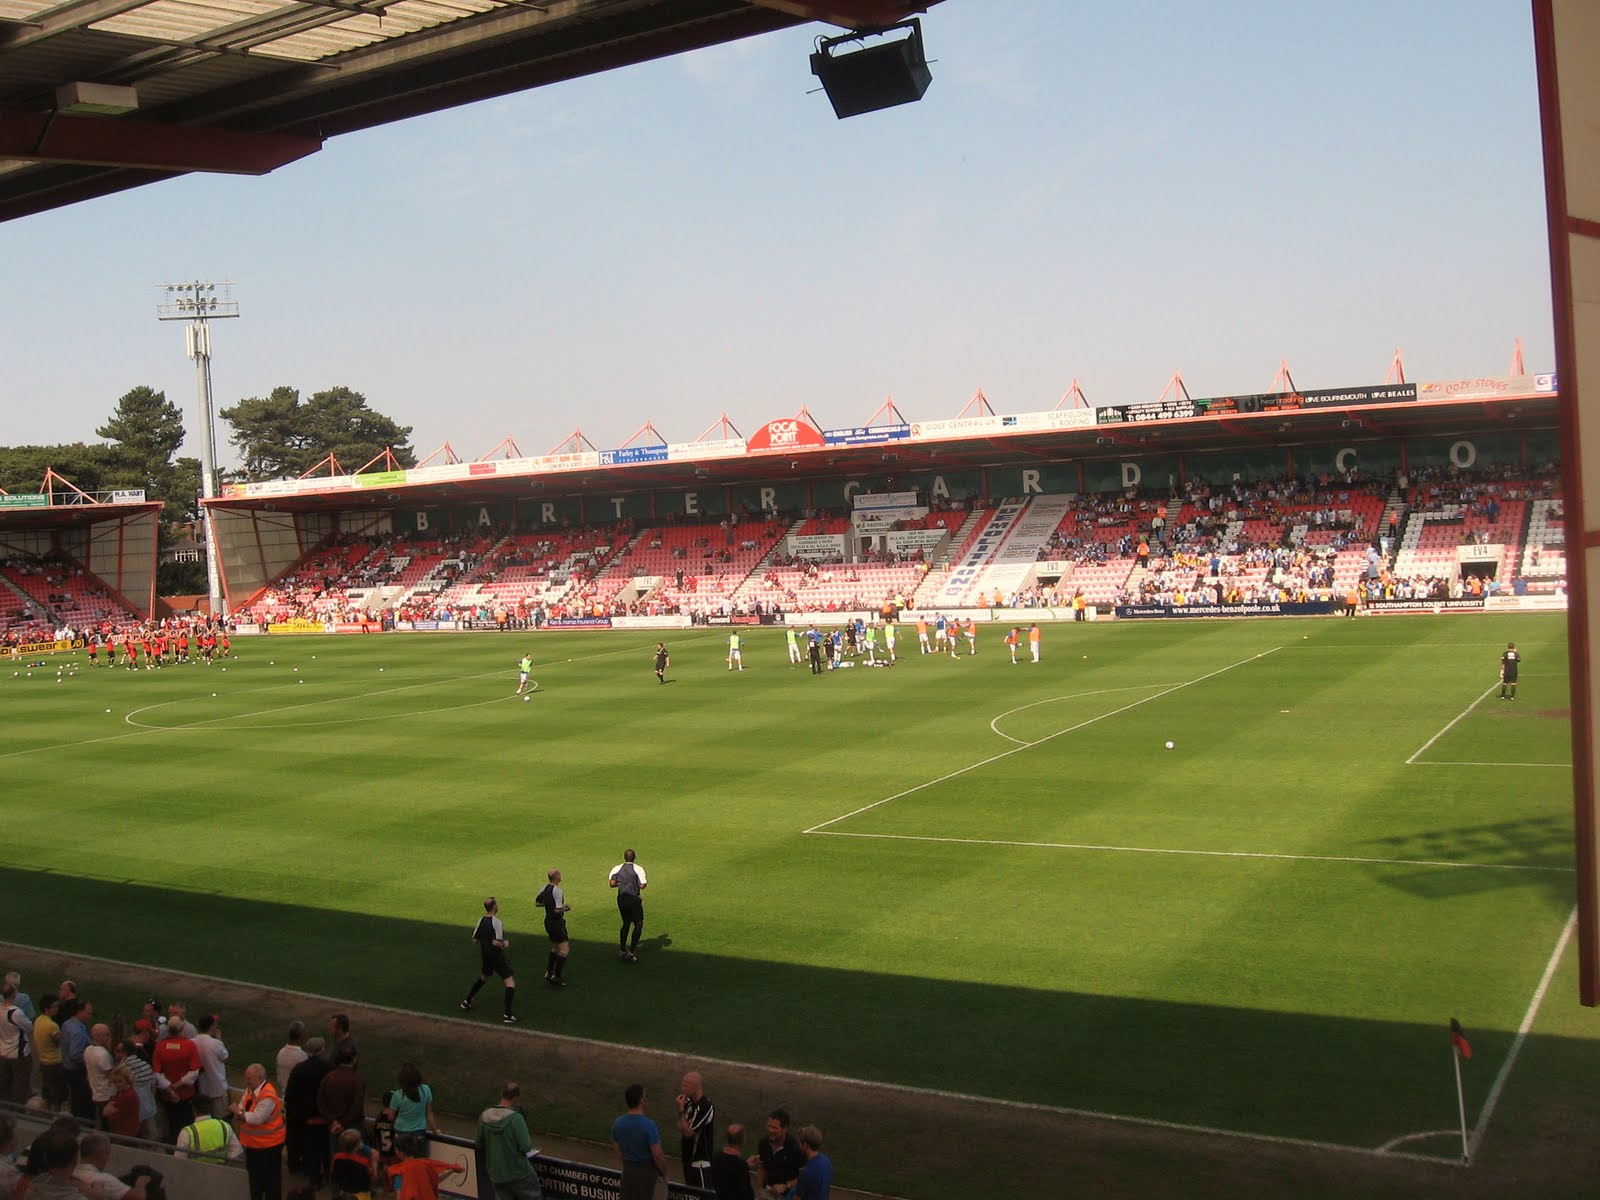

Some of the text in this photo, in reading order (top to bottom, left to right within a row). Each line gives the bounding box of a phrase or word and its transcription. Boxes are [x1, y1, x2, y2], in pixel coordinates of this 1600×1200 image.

[1445, 381, 1471, 395] COZY
[1475, 378, 1510, 391] STOVES
[1320, 393, 1368, 403] BOURNEMOUTH
[1387, 389, 1415, 398] BEALES
[1047, 409, 1093, 421] SCAFFOLDING
[1135, 412, 1156, 421] 0844
[1157, 411, 1173, 420] 499
[1173, 409, 1194, 418] 6399
[768, 420, 799, 434] FOCAL
[925, 418, 997, 431] GOLF CENTRAL UK
[1059, 417, 1090, 426] ROOFING
[769, 431, 798, 443] POINT
[618, 449, 635, 459] Farley
[634, 448, 640, 456] &
[4, 494, 46, 502] SOLUTIONS
[128, 489, 144, 498] HART
[1473, 545, 1488, 556] EV4
[1046, 562, 1060, 572] EV3
[1172, 603, 1281, 615] www.mercedes-benzofpoole.co.uk
[1375, 599, 1484, 609] SOUTHAMPTON SOLENT UNIVERSITY
[595, 617, 609, 625] Group
[708, 614, 731, 624] Seward
[549, 1165, 588, 1182] CHAMBER
[589, 1174, 601, 1184] OF
[602, 1177, 621, 1189] COM
